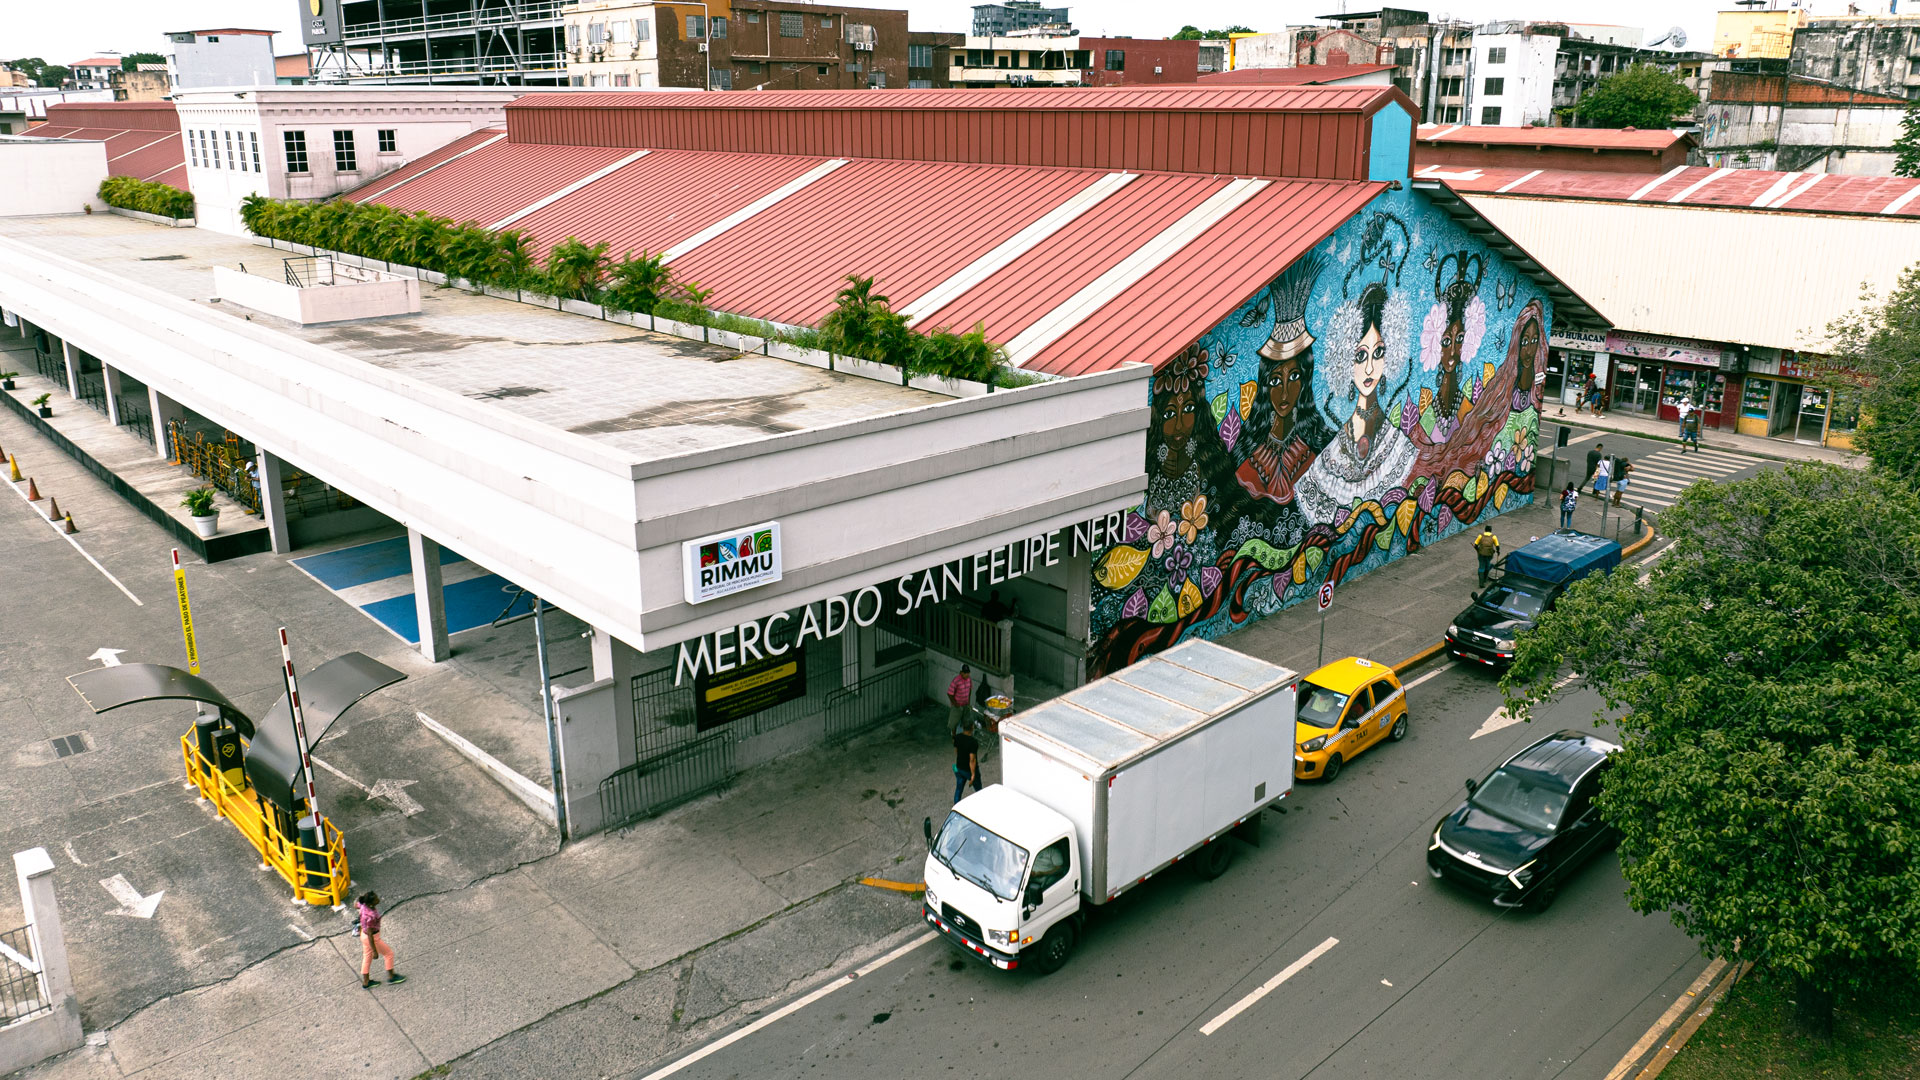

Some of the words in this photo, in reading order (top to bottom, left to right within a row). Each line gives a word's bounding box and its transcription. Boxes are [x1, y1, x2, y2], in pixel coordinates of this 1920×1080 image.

[1565, 331, 1606, 343] HURACAN
[701, 552, 773, 587] RIMMU
[674, 585, 882, 686] MERCADO
[896, 558, 963, 616] SAN
[973, 529, 1061, 591] FELIPE
[1073, 509, 1128, 558] NERI
[1356, 729, 1368, 740] TAXI
